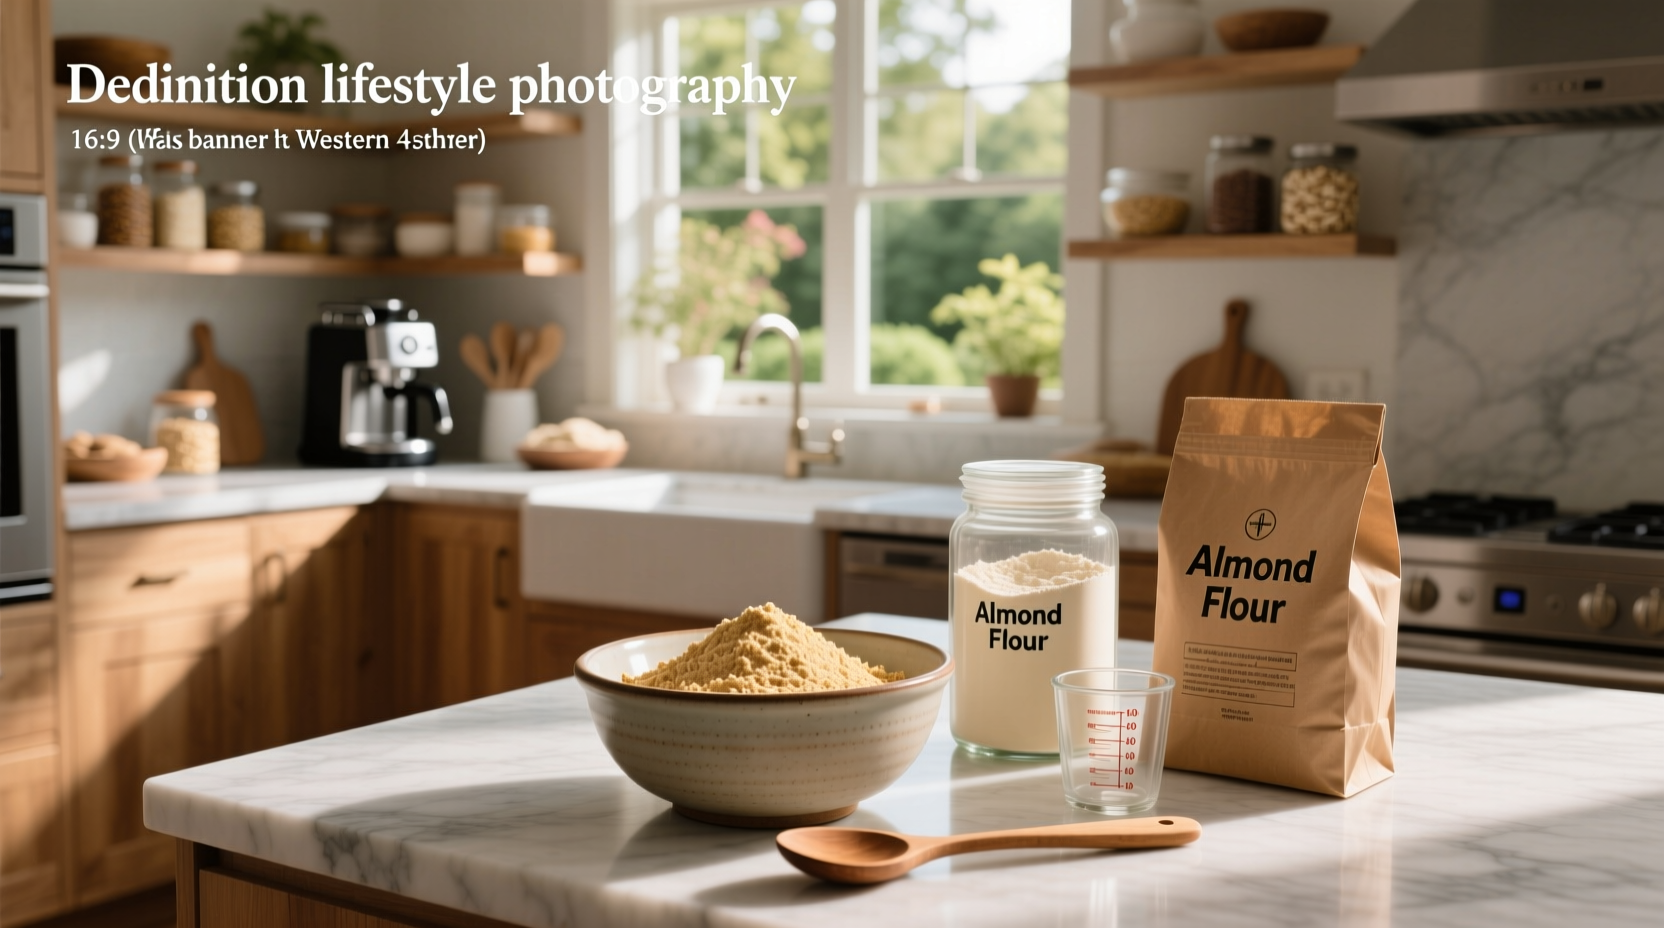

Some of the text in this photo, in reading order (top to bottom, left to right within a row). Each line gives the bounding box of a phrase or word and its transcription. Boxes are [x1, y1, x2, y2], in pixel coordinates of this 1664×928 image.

[1185, 544, 1317, 583] Almond
[975, 601, 1062, 625] Almond
[1201, 585, 1287, 624] Flour
[989, 628, 1049, 651] Flour
